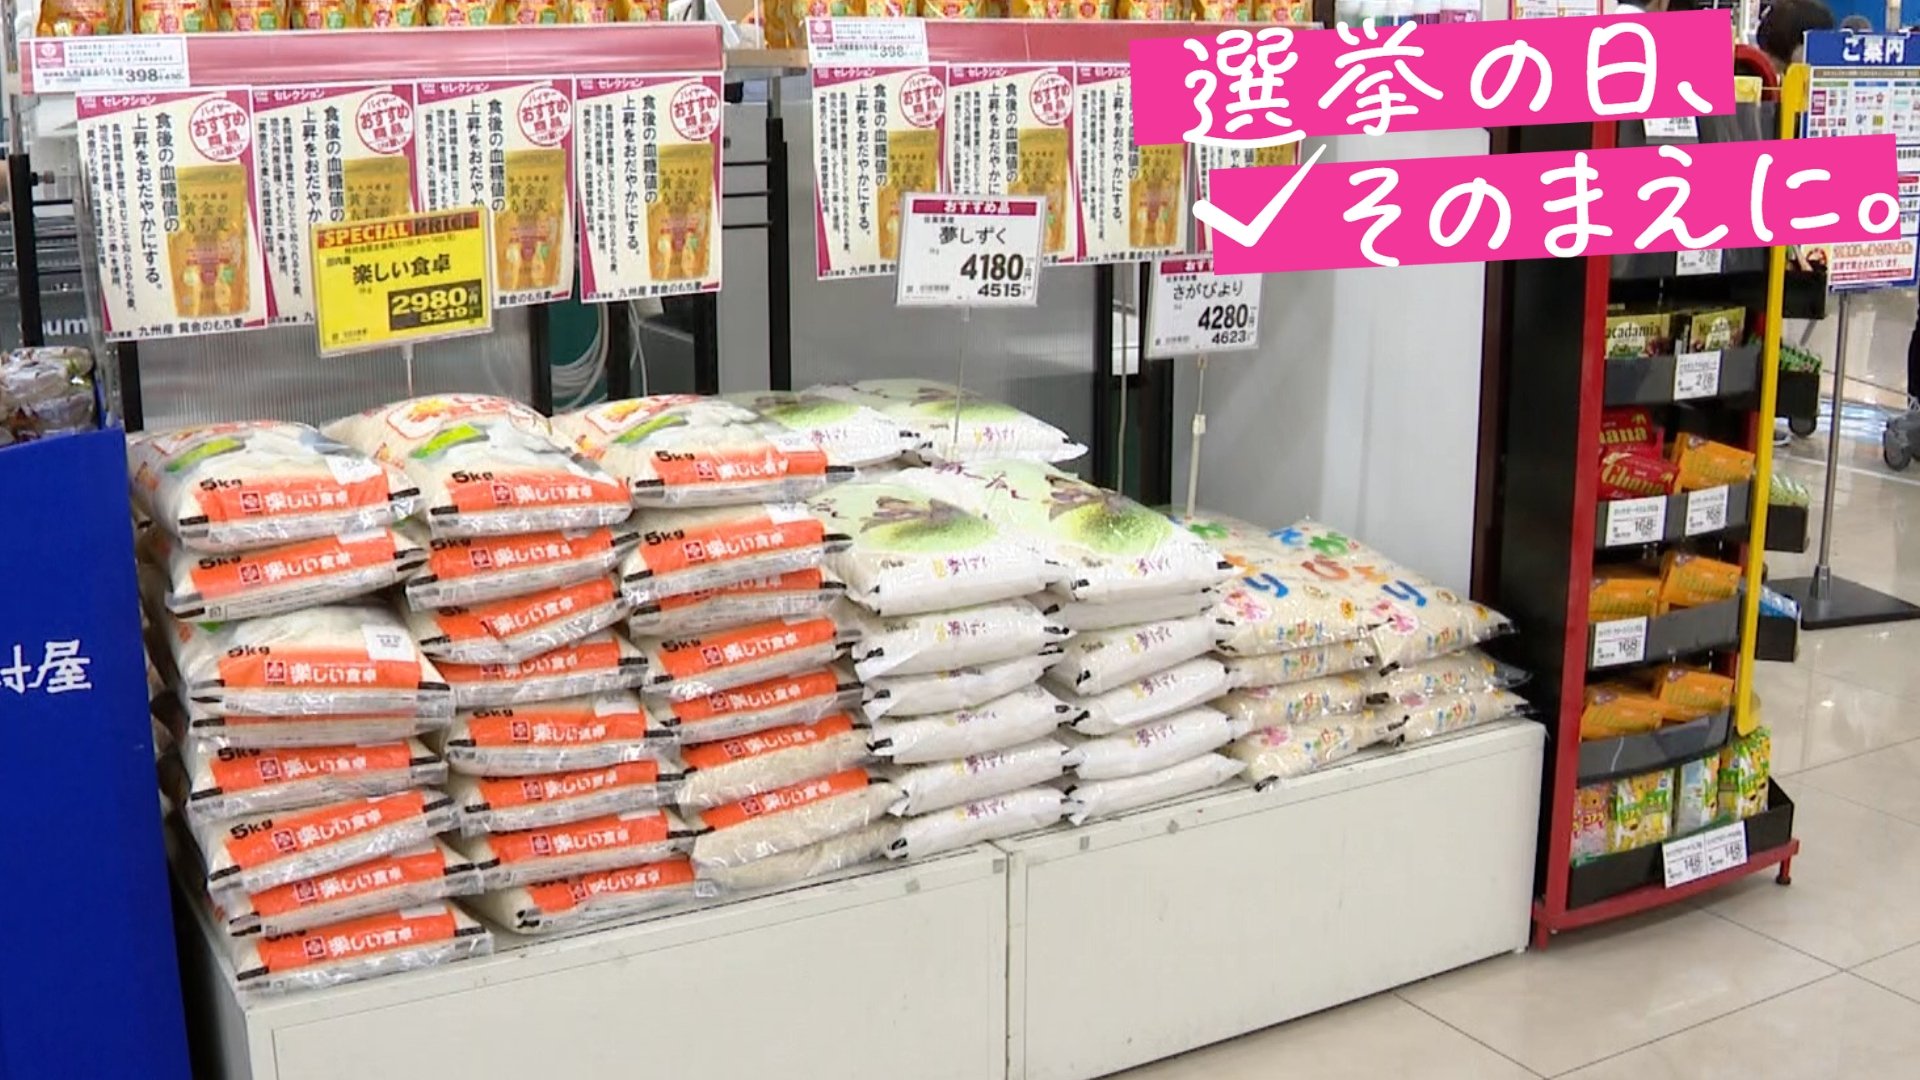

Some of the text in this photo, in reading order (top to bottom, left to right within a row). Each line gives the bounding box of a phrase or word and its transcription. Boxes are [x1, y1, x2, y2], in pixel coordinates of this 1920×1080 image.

[1842, 36, 1906, 63] ご案内
[125, 68, 158, 83] 398
[598, 79, 643, 89] セレクション
[273, 89, 324, 101] セレクション
[440, 82, 489, 94] セレクション
[903, 85, 943, 105] おすすめ
[102, 96, 156, 108] セレクション
[522, 99, 568, 122] おすすめ
[674, 96, 717, 118] おすすめ
[193, 113, 247, 137] おすすめ
[360, 105, 410, 130] おすすめ
[874, 83, 888, 186] 食後の血糖値の
[1005, 83, 1018, 182] 食後の血糖値の
[488, 99, 506, 212] 食後の血糖値の
[642, 95, 657, 204] 食後の血糖値の
[856, 83, 870, 235] 上昇をおだやかにする。
[1112, 82, 1124, 225] 上昇をおだやかにする。
[155, 111, 180, 233] 食後の血糖値の
[324, 105, 345, 222] 食後の血糖値の
[622, 95, 640, 255] 上昇をおだやかにする。
[131, 114, 162, 290] 上昇をおだやかにする。
[944, 200, 1011, 215] おすすめ品
[323, 222, 409, 247] SPECIAL
[939, 226, 1007, 245] 夢しずく
[352, 253, 451, 286] 楽しい食卓
[850, 264, 876, 275] 九州産
[960, 253, 1024, 281] 4180
[390, 286, 468, 316] 2980
[499, 290, 551, 306] 黄金のもち麦
[618, 286, 646, 298] 九州産
[650, 281, 702, 295] 黄金のもち麦
[977, 283, 1021, 297] 4515
[1173, 280, 1244, 300] さがびより
[42, 316, 89, 336] um
[139, 323, 173, 336] 九州産
[178, 318, 244, 334] 黄金のもち麦
[420, 308, 468, 323] 3219
[1198, 303, 1249, 330] 4280
[1211, 329, 1247, 344] 4623
[655, 449, 695, 463] 5kg
[451, 469, 494, 484] 5kg
[716, 457, 790, 480] 楽しい食卓
[200, 476, 242, 492] 5kg
[514, 484, 593, 505] 楽しい食卓
[264, 489, 349, 512] 楽しい食卓
[643, 528, 686, 546] 5kg
[705, 530, 786, 559] 楽しい食卓
[263, 551, 352, 580] 楽しい食卓
[494, 543, 573, 567] 楽しい食卓
[491, 595, 575, 636] 楽しい食卓
[227, 645, 271, 659] 5kg
[722, 631, 799, 663] 楽しい食卓
[290, 662, 377, 684] 楽しい食卓
[727, 683, 801, 710] 楽しい食卓
[532, 723, 607, 743] 楽しい食卓
[744, 728, 817, 753] 楽しい食卓
[282, 755, 368, 779] 楽しい食卓
[543, 770, 618, 799] 楽しい食卓
[761, 780, 832, 811] 楽しい食卓
[229, 818, 274, 841] 5kg
[296, 808, 383, 845] 楽しい食卓
[552, 827, 629, 854] 楽しい食卓
[318, 865, 404, 898] 楽しい食卓
[588, 869, 661, 896] 楽しい食卓
[326, 926, 414, 956] 楽しい食卓
